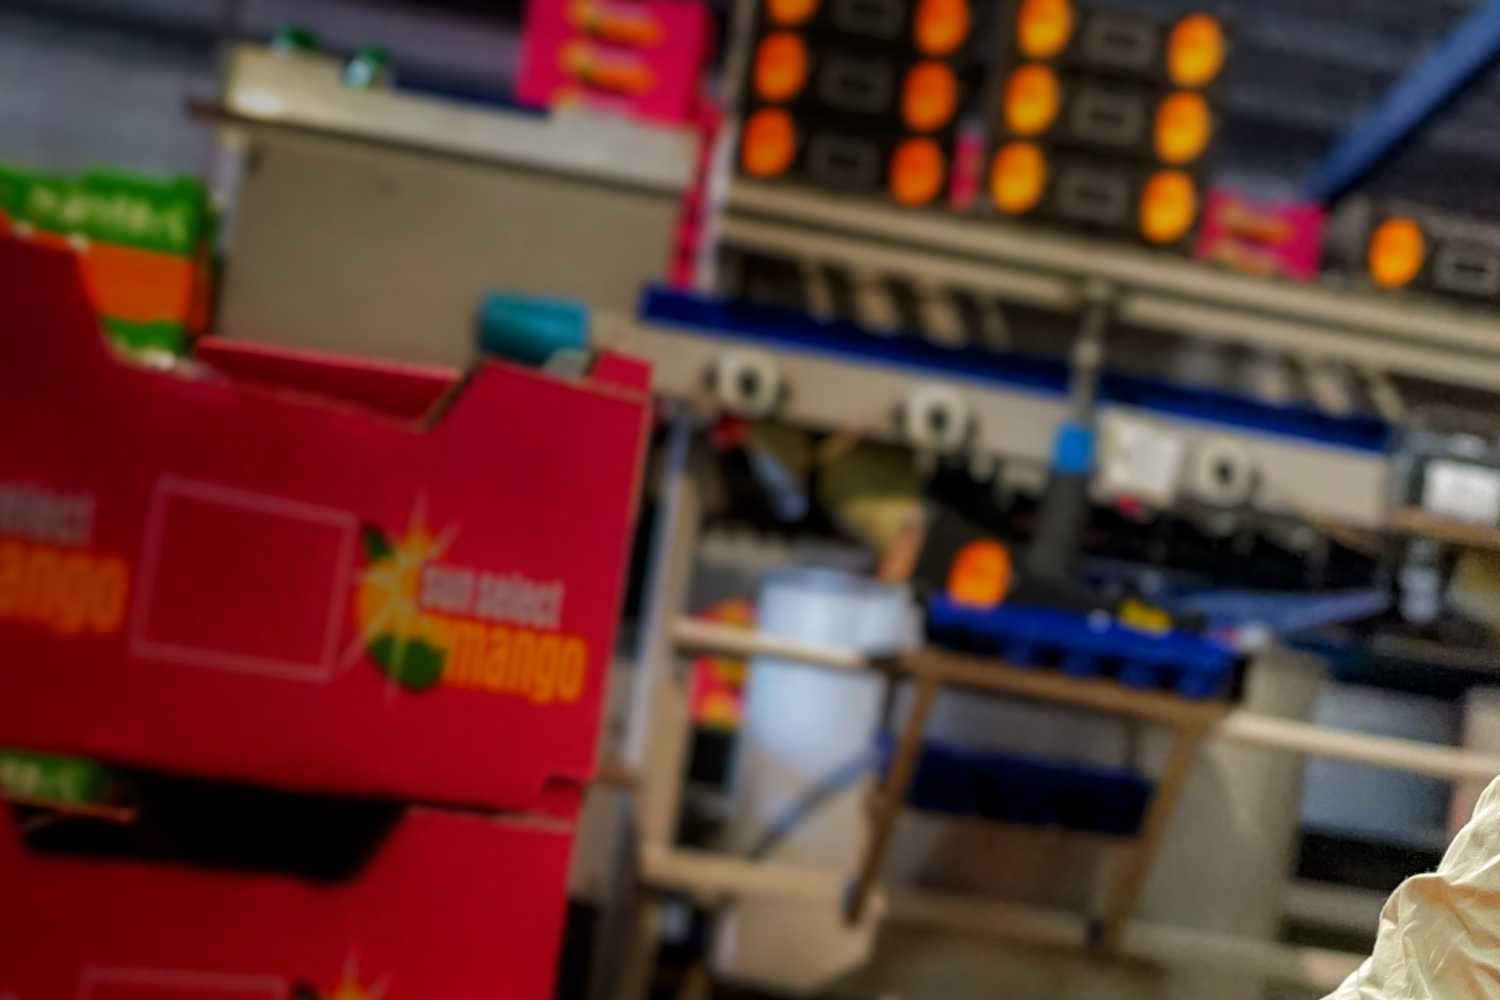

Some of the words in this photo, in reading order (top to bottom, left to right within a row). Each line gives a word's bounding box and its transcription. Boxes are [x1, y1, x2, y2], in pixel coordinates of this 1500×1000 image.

[0, 543, 132, 636] ango
[476, 568, 567, 632] select
[446, 617, 588, 706] mango
